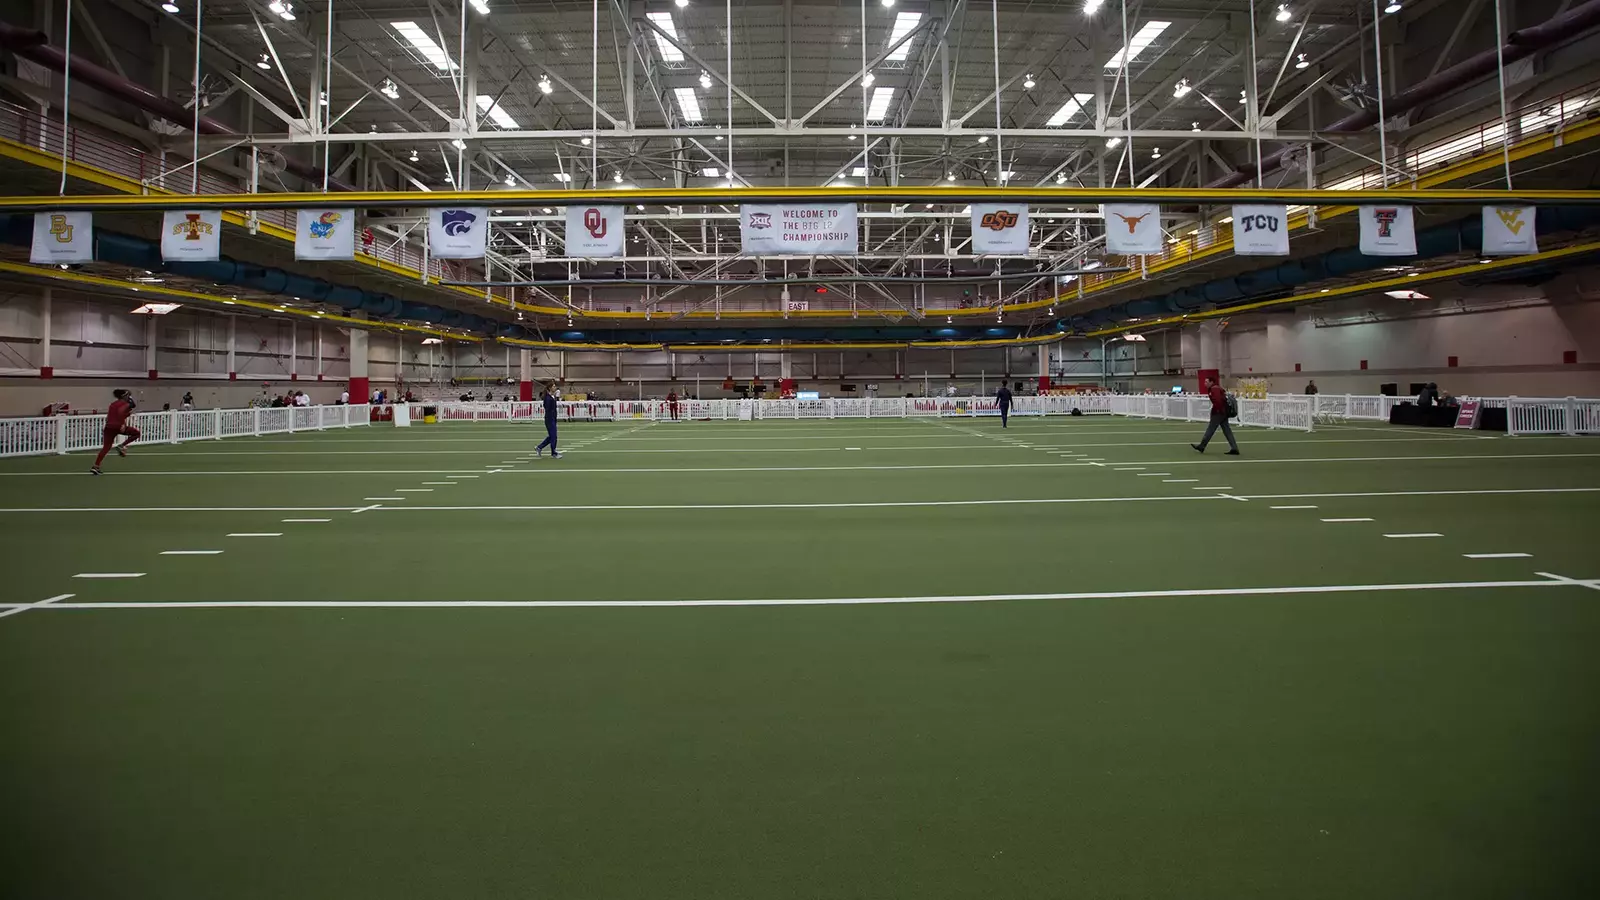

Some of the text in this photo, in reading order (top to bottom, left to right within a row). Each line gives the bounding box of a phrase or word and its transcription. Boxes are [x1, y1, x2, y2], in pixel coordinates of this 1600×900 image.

[783, 209, 838, 218] WELCOME TO
[584, 208, 607, 238] OU
[783, 222, 799, 230] THE
[823, 221, 833, 229] 12
[980, 210, 1019, 231] OSU
[1241, 215, 1278, 232] TCU
[172, 221, 213, 235] STATE
[783, 233, 849, 242] CHAMPIONSHIP
[788, 303, 807, 311] EAST
